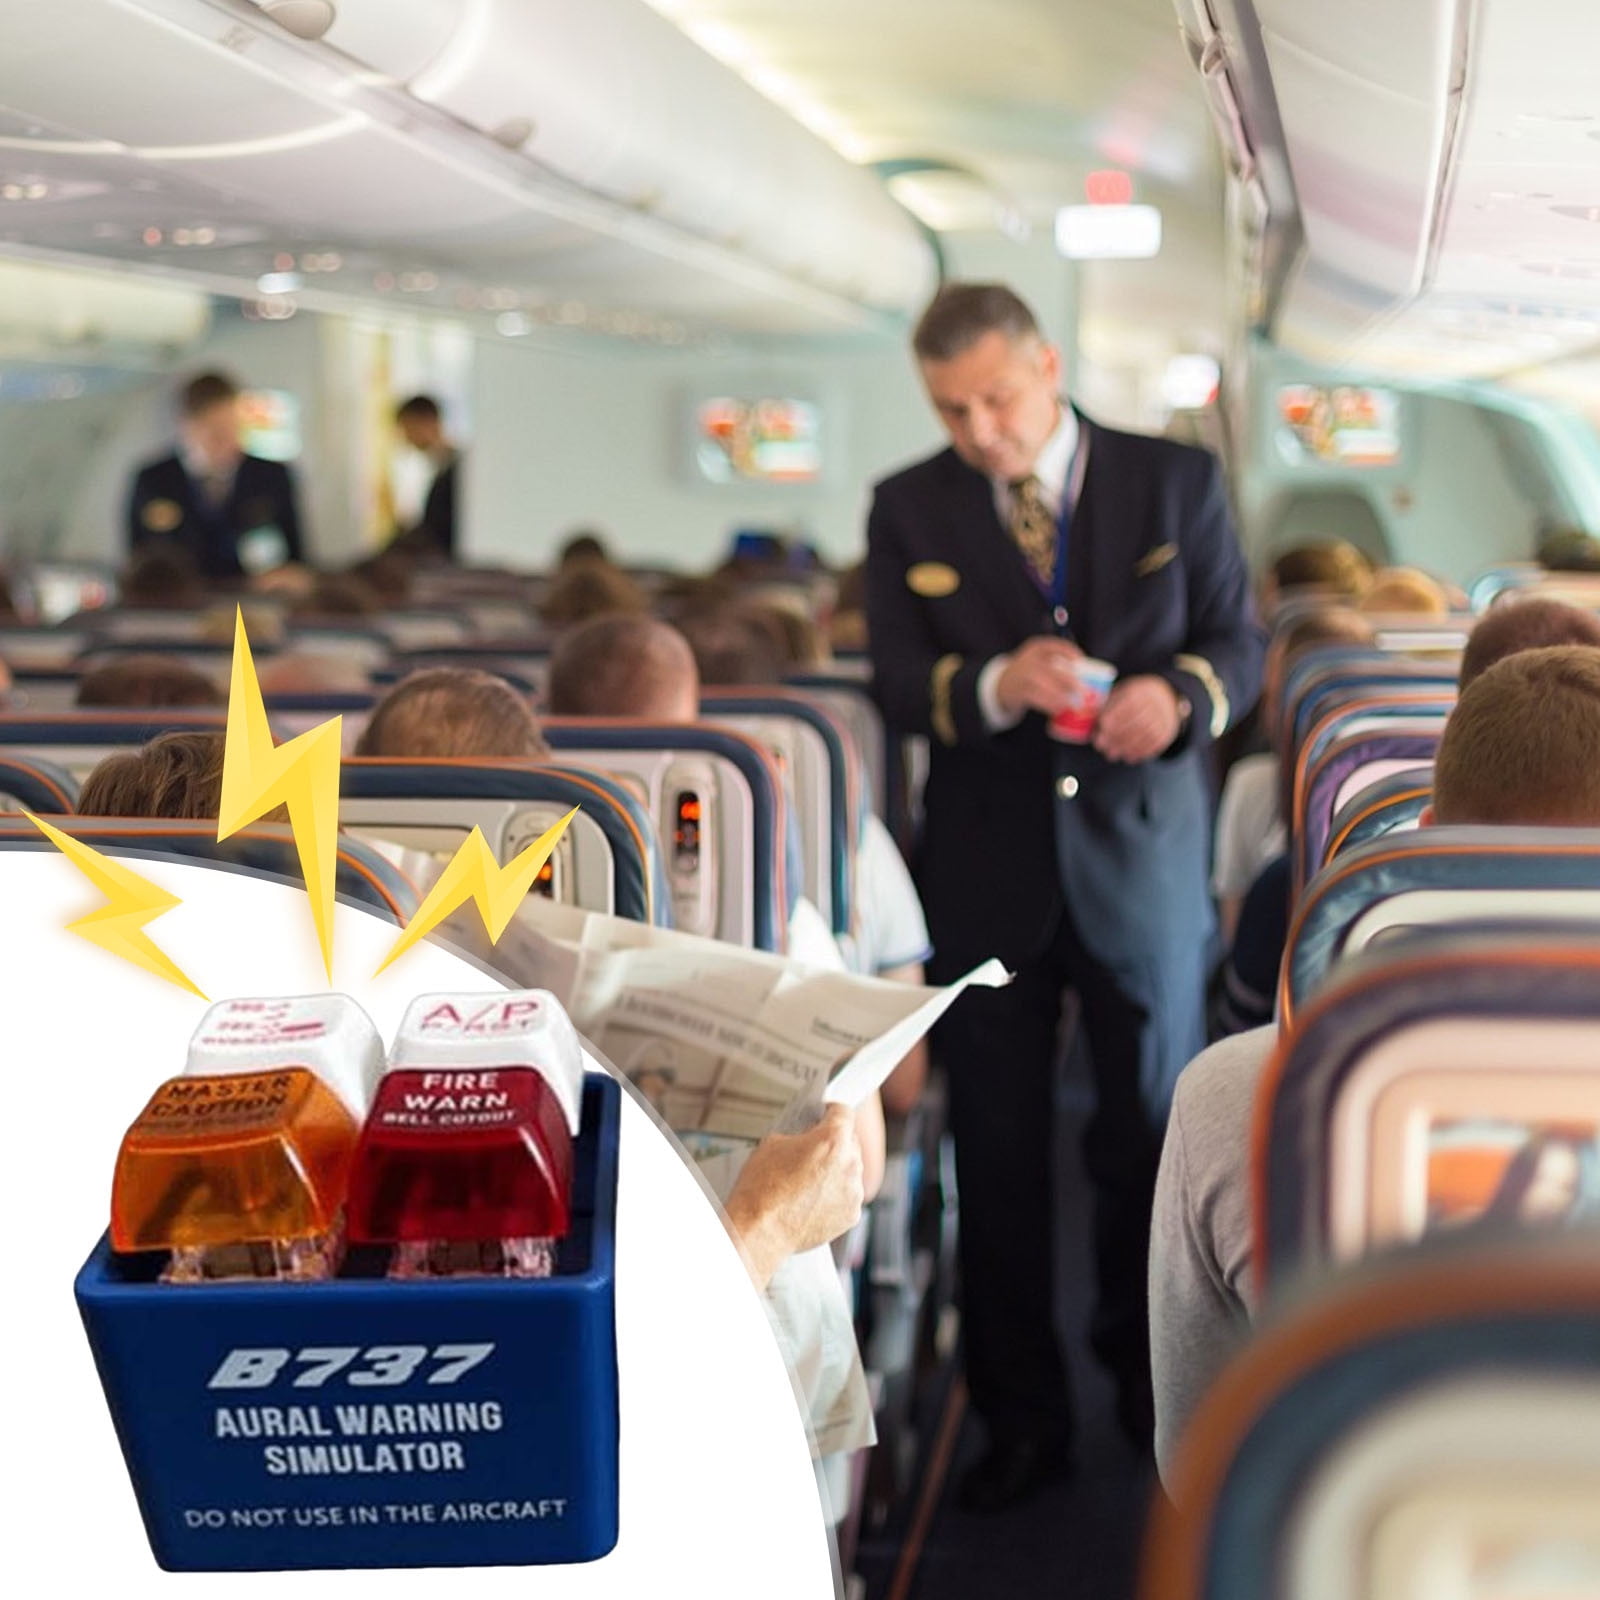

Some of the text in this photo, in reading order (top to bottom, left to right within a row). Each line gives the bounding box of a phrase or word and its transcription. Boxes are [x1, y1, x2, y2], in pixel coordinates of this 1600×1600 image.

[422, 1001, 539, 1023] A/P
[167, 1075, 292, 1099] MASTER
[422, 1071, 500, 1091] FIRE
[151, 1094, 287, 1117] CAUTION
[403, 1092, 509, 1111] WARN
[381, 1112, 432, 1125] BELL
[207, 1342, 496, 1389] B737
[215, 1401, 503, 1438] AURAL WARNING
[264, 1441, 466, 1475] SIMULATOR
[184, 1499, 568, 1528] DO NOT USE IN THE AIRCRAFT
